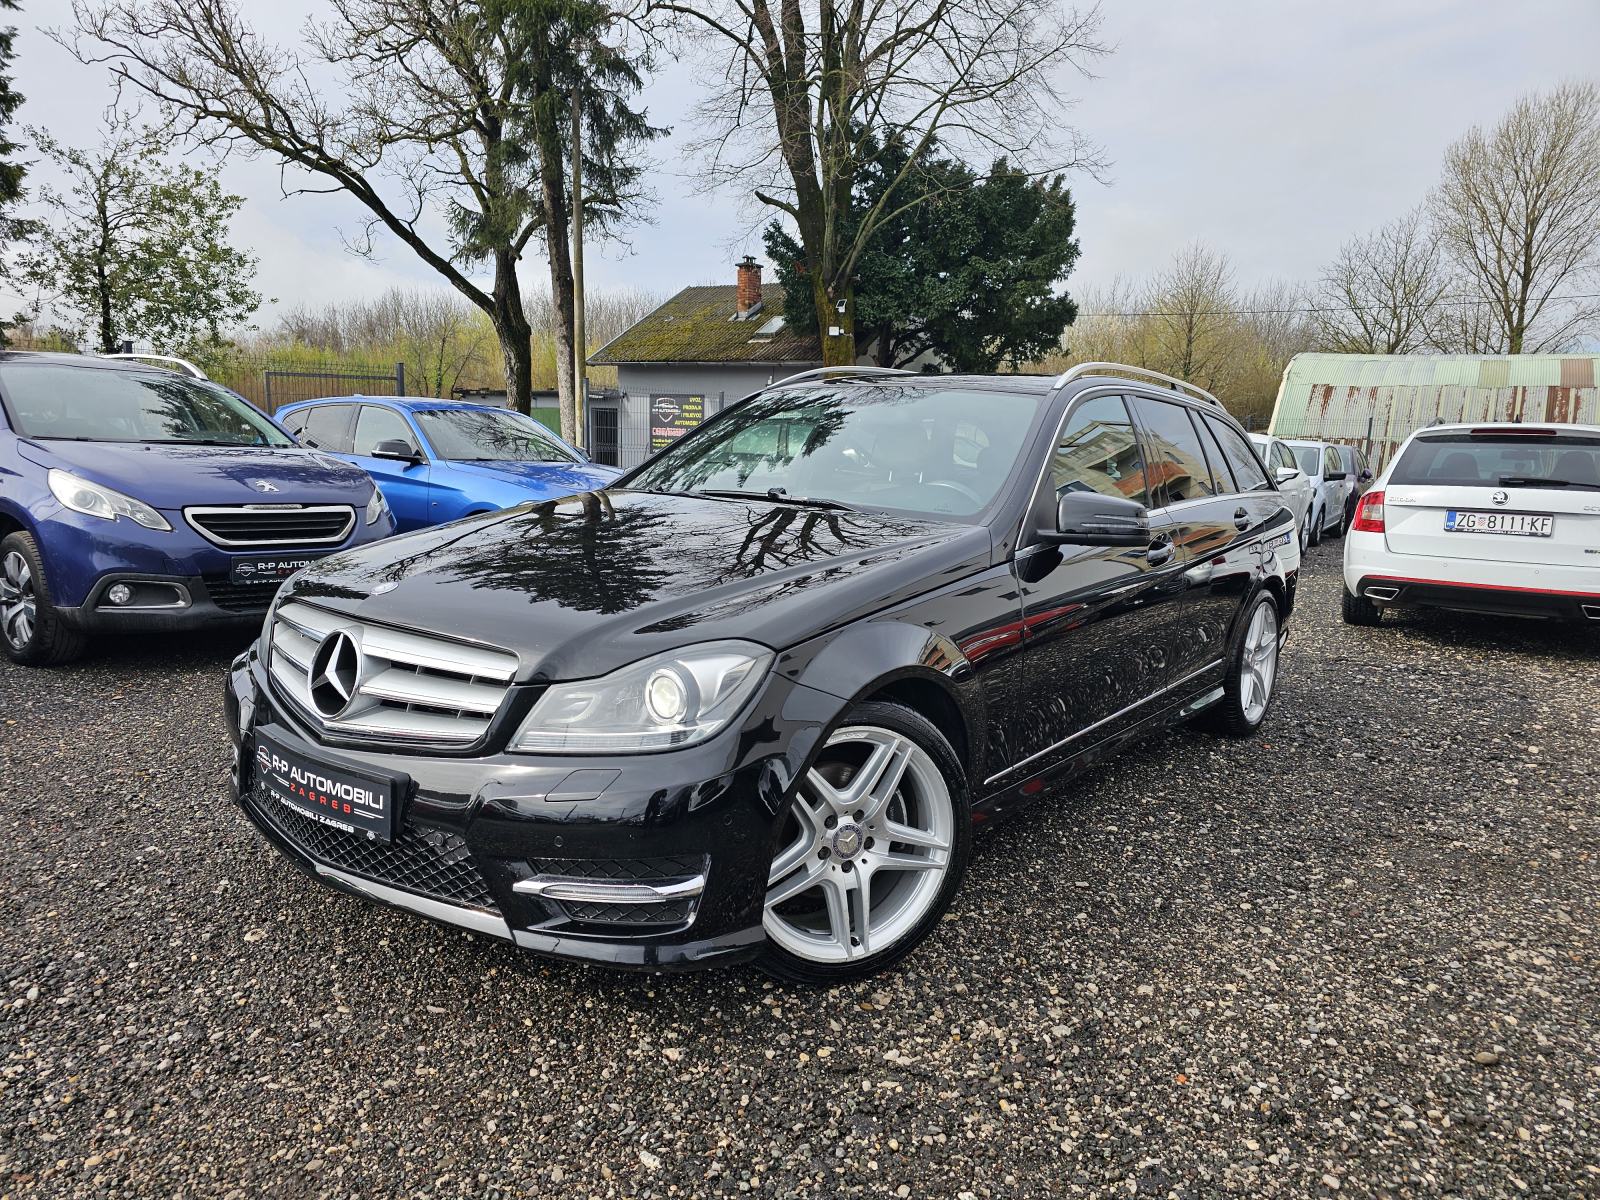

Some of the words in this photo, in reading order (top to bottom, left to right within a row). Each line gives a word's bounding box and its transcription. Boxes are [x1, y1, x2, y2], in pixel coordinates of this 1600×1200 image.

[1456, 513, 1477, 528] ZG
[257, 562, 276, 570] R-P
[272, 754, 289, 773] R-P
[290, 766, 384, 810] AUTOMOBILI
[289, 782, 351, 813] ZAGREB
[270, 790, 280, 799] R-P
[280, 797, 318, 821] AUTOMOBILI
[319, 815, 355, 833] ZAGREB
